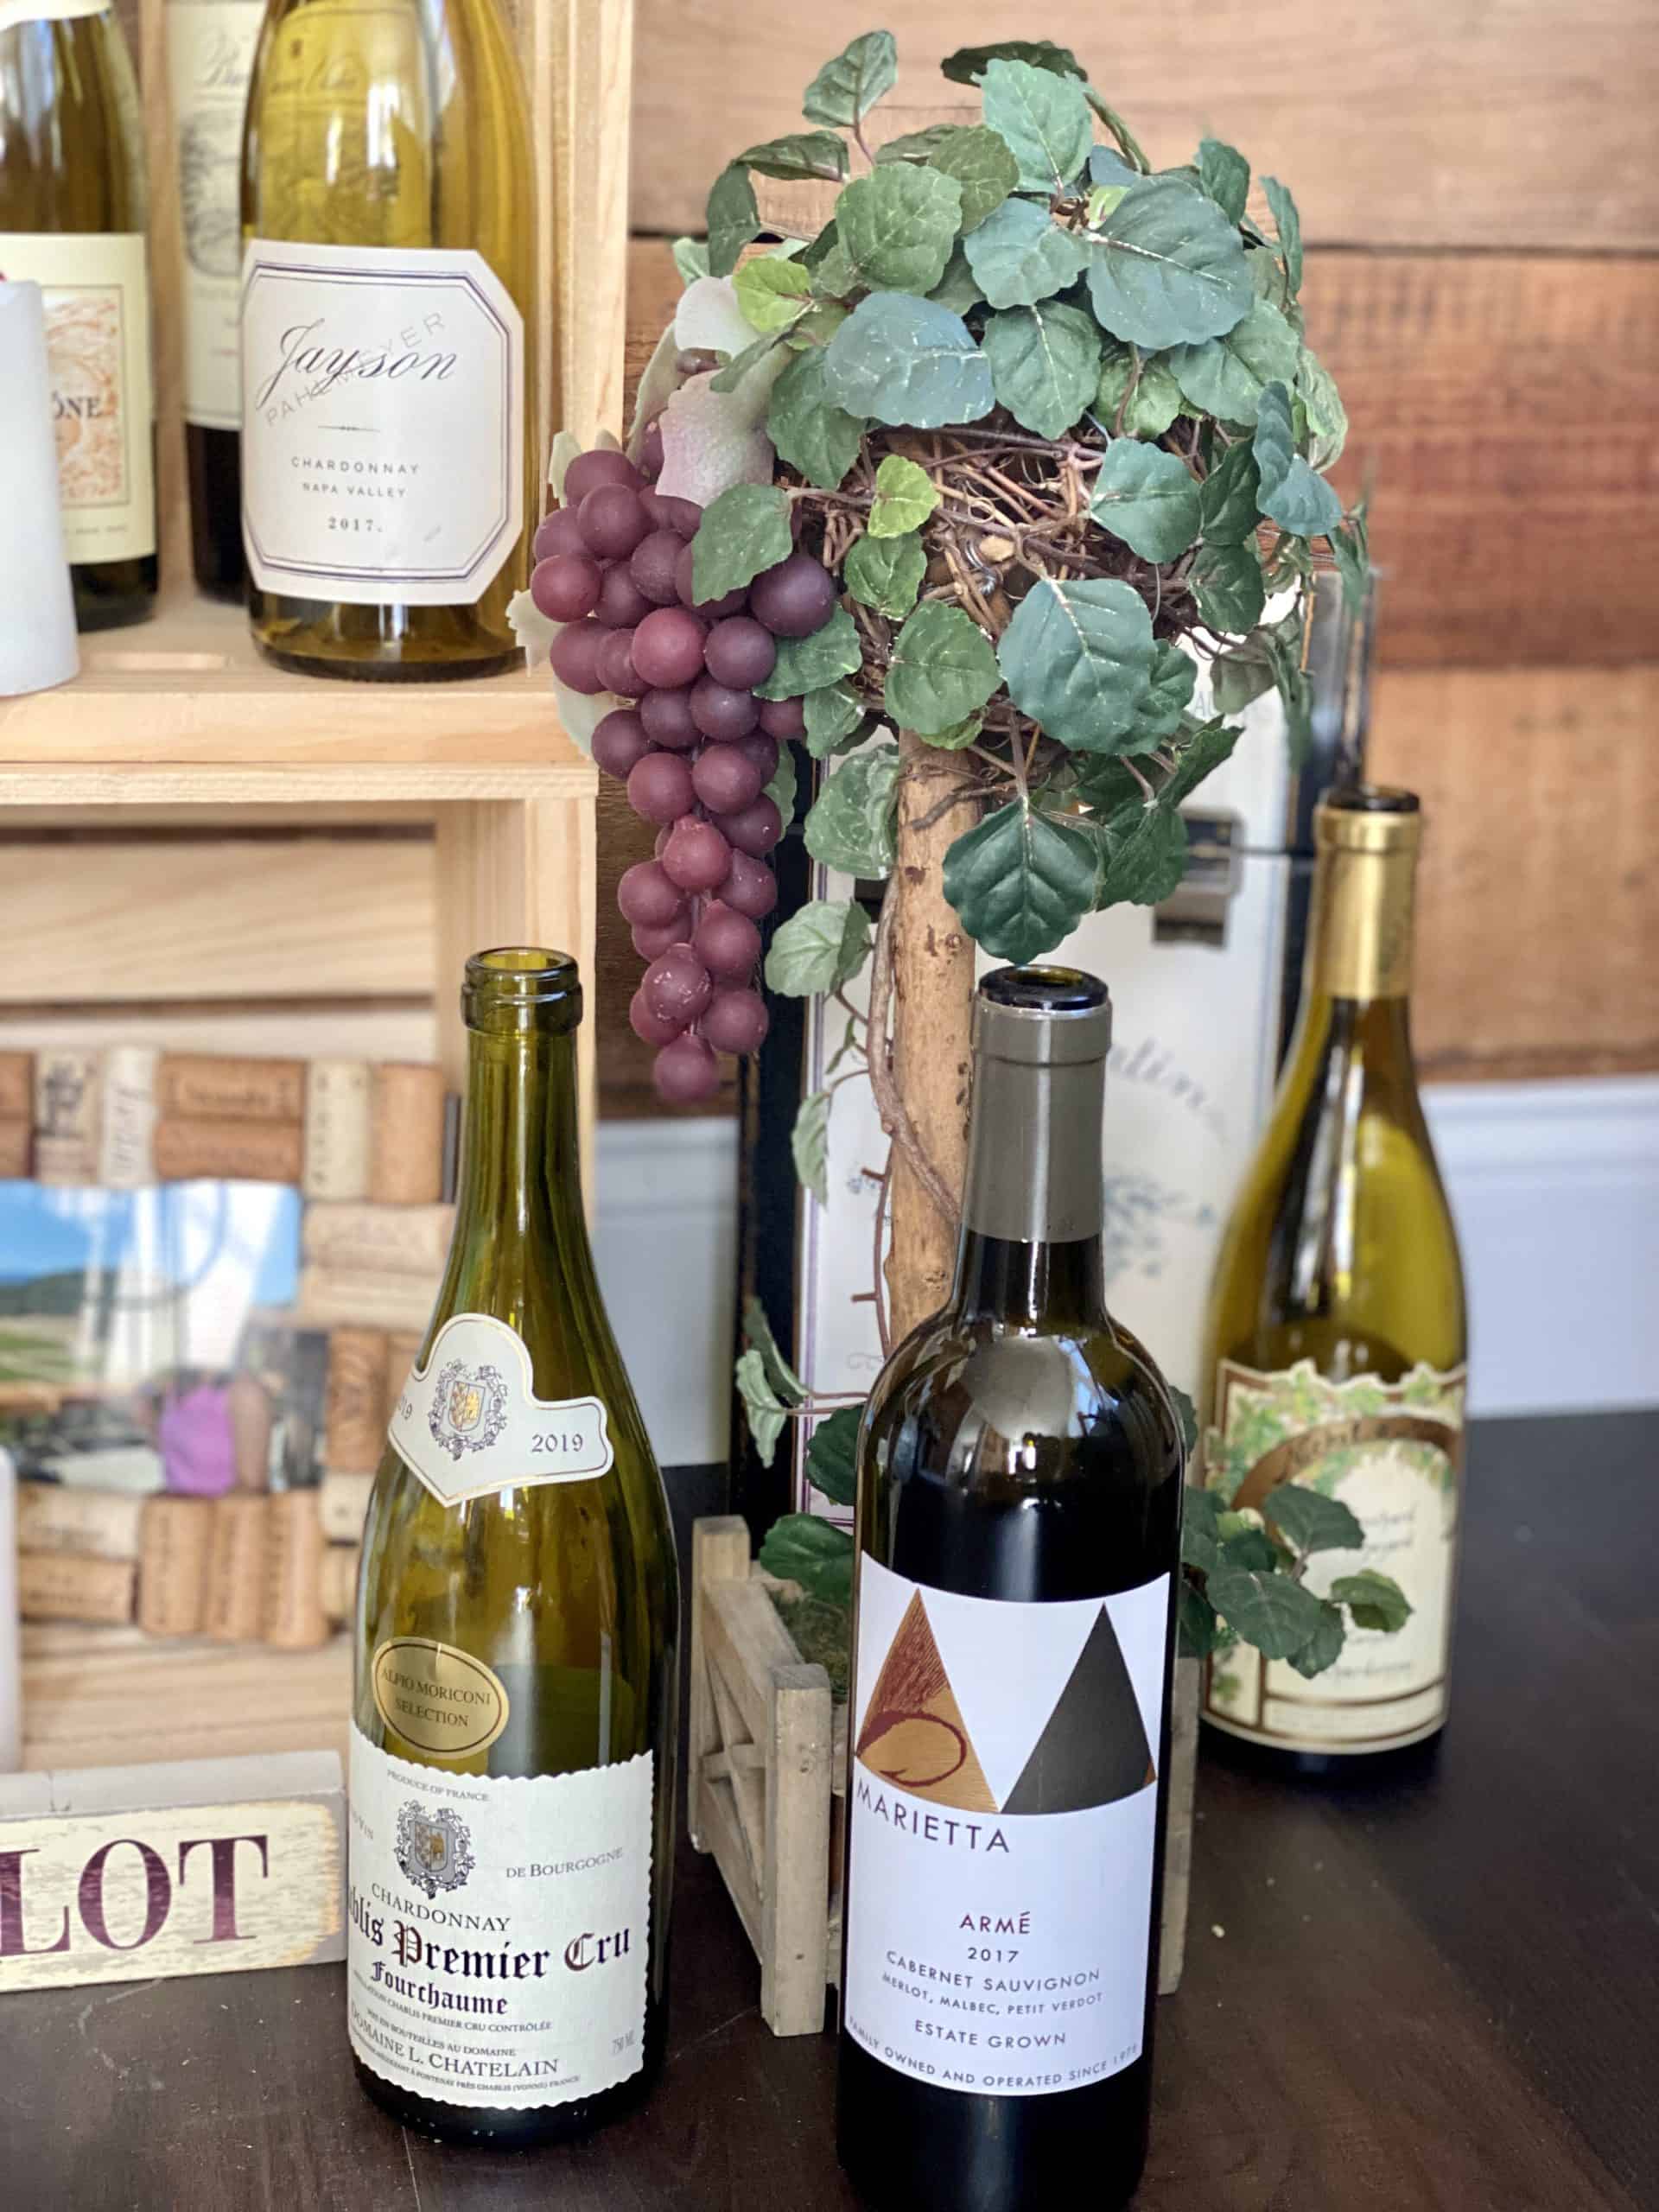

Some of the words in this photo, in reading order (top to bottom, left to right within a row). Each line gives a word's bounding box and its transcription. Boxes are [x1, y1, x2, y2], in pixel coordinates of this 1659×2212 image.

[256, 317, 457, 411] Jayson
[290, 455, 420, 475] CHARDONNAY
[302, 481, 339, 495] NAPA
[347, 484, 407, 499] VALLEY
[531, 1433, 584, 1452] 2019
[380, 1667, 415, 1691] ALFIO
[416, 1680, 491, 1706] MORICONI
[394, 1697, 470, 1727] SELECTION
[387, 1769, 429, 1792] PRODUCE
[429, 1784, 444, 1796] OF
[446, 1788, 491, 1802] FRANCE
[856, 1777, 1010, 1853] MARIETTA
[505, 1866, 526, 1878] DE
[530, 1847, 624, 1877] BOURGOGNE
[0, 1834, 269, 1958] LOT
[372, 1882, 512, 1932] CHARDONNAY
[959, 1910, 1031, 1935] ARMÉ
[391, 1919, 550, 1980] Premier
[564, 1928, 631, 1973] Cru
[967, 1947, 1020, 1964] 2017
[370, 1960, 508, 2014] Fourchaume
[886, 1950, 974, 1989] CABERNET
[982, 1968, 1100, 1993] SAUVIGNON
[882, 1971, 934, 2005] MERLOT,
[939, 1994, 1001, 2016] MALBEC,
[1007, 2003, 1046, 2016] PETIT
[1052, 1992, 1103, 2012] VERDOT
[386, 1998, 421, 2020] CHABLIS
[421, 2012, 462, 2029] PREMIER
[464, 2020, 486, 2031] CRU
[487, 2020, 552, 2033] CONTRÔLÉE
[391, 2023, 445, 2050] BOUTEILLES
[447, 2043, 461, 2054] AU
[463, 2045, 518, 2057] DOMAINE
[914, 2018, 979, 2046] ESTATE
[988, 2032, 1066, 2050] GROWN
[409, 2046, 424, 2065] L.
[429, 2052, 559, 2077] CHATELAIN
[849, 2015, 880, 2050] FAMILY
[884, 2046, 936, 2075] OWNED
[942, 2069, 976, 2084] AND
[982, 2073, 1063, 2088] OPERATED
[1069, 2060, 1108, 2082] SINCE
